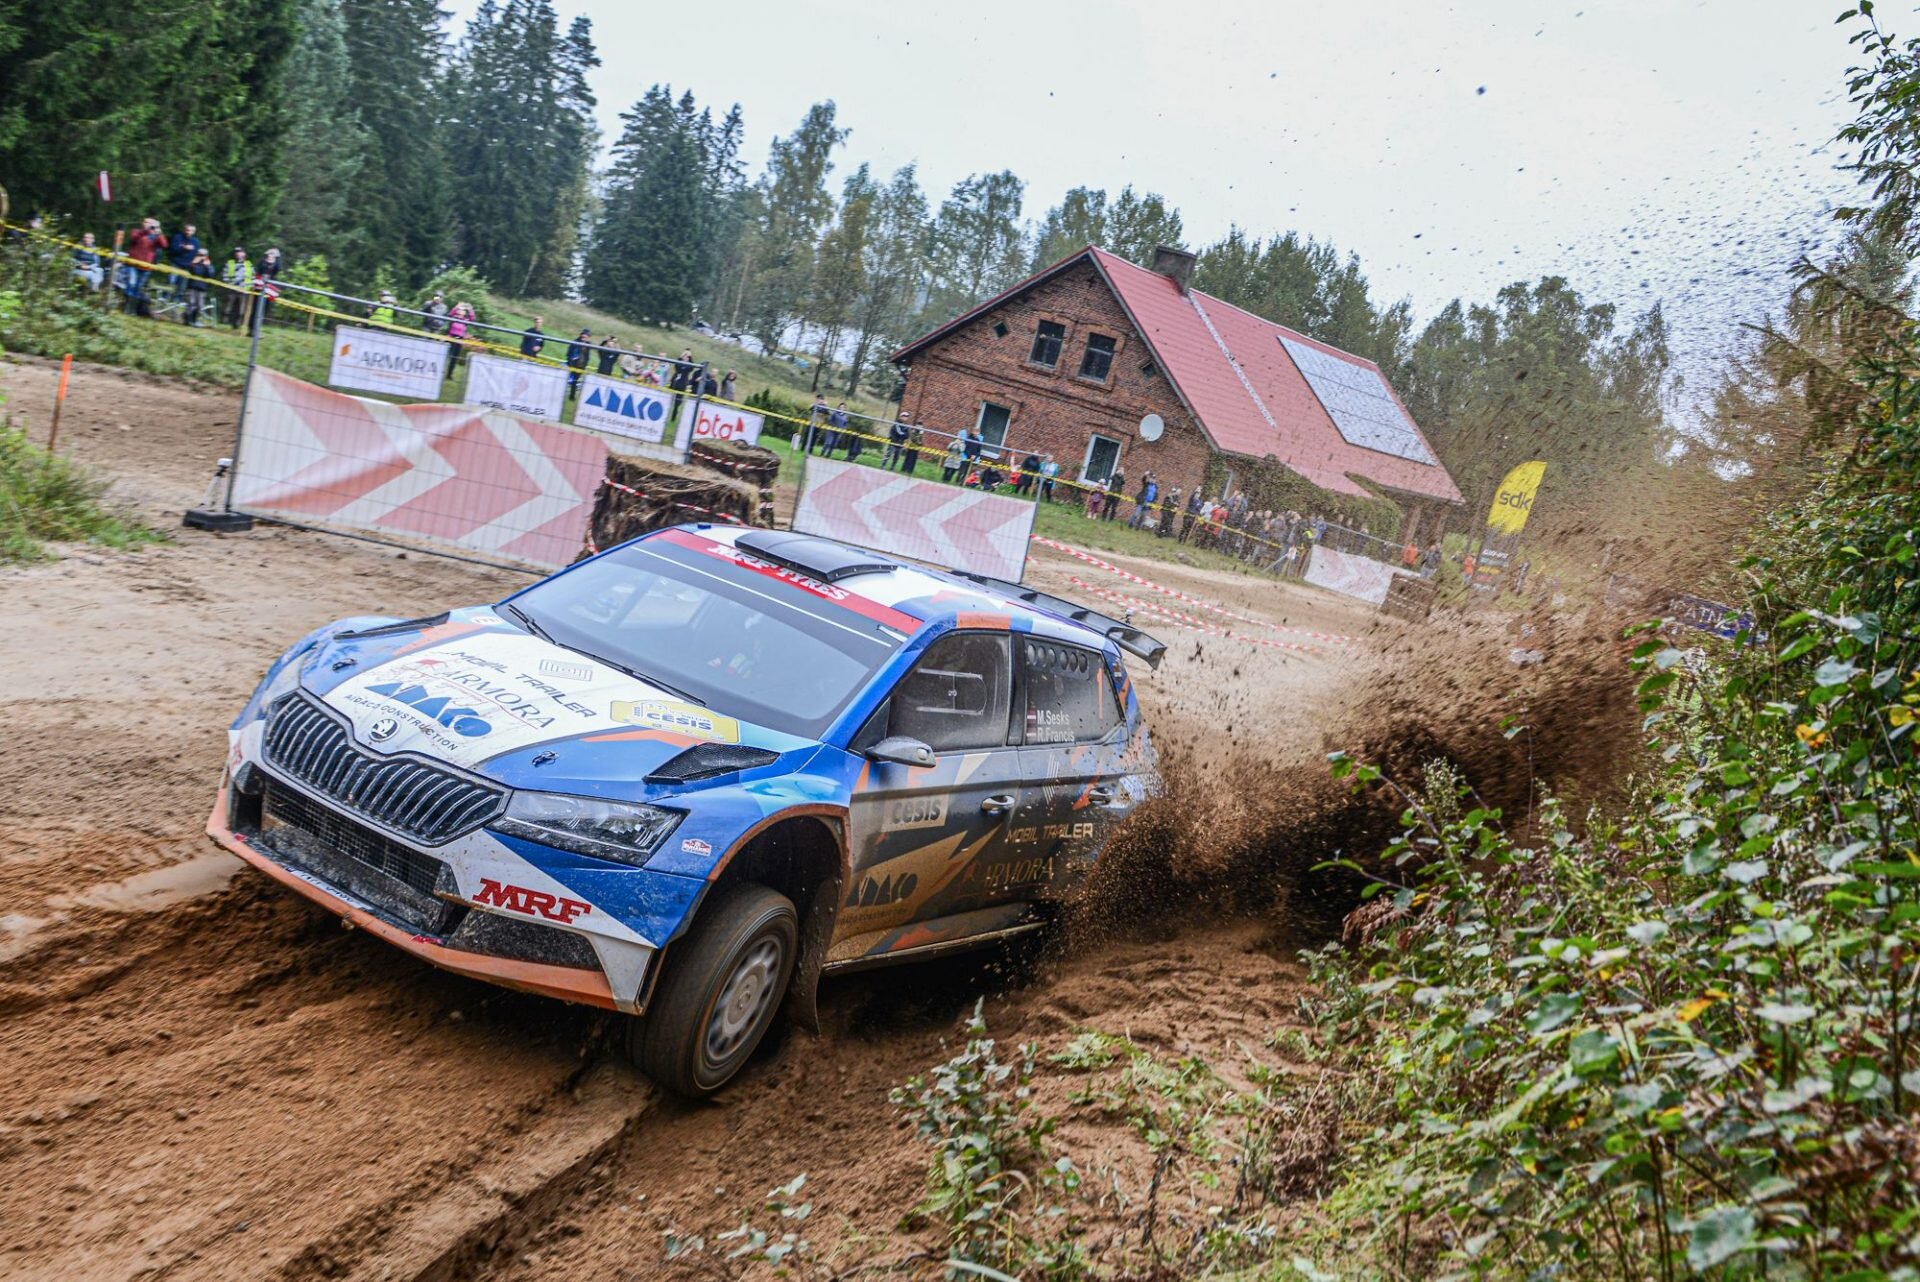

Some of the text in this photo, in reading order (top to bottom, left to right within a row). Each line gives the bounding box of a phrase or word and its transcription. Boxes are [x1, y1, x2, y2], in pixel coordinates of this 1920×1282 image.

[360, 350, 438, 376] ARMORA
[697, 410, 733, 440] bta
[1498, 489, 1532, 511] sdk
[515, 673, 598, 718] TRAILER
[380, 704, 458, 751] CONSTRUCTION
[472, 878, 592, 924] MRF
